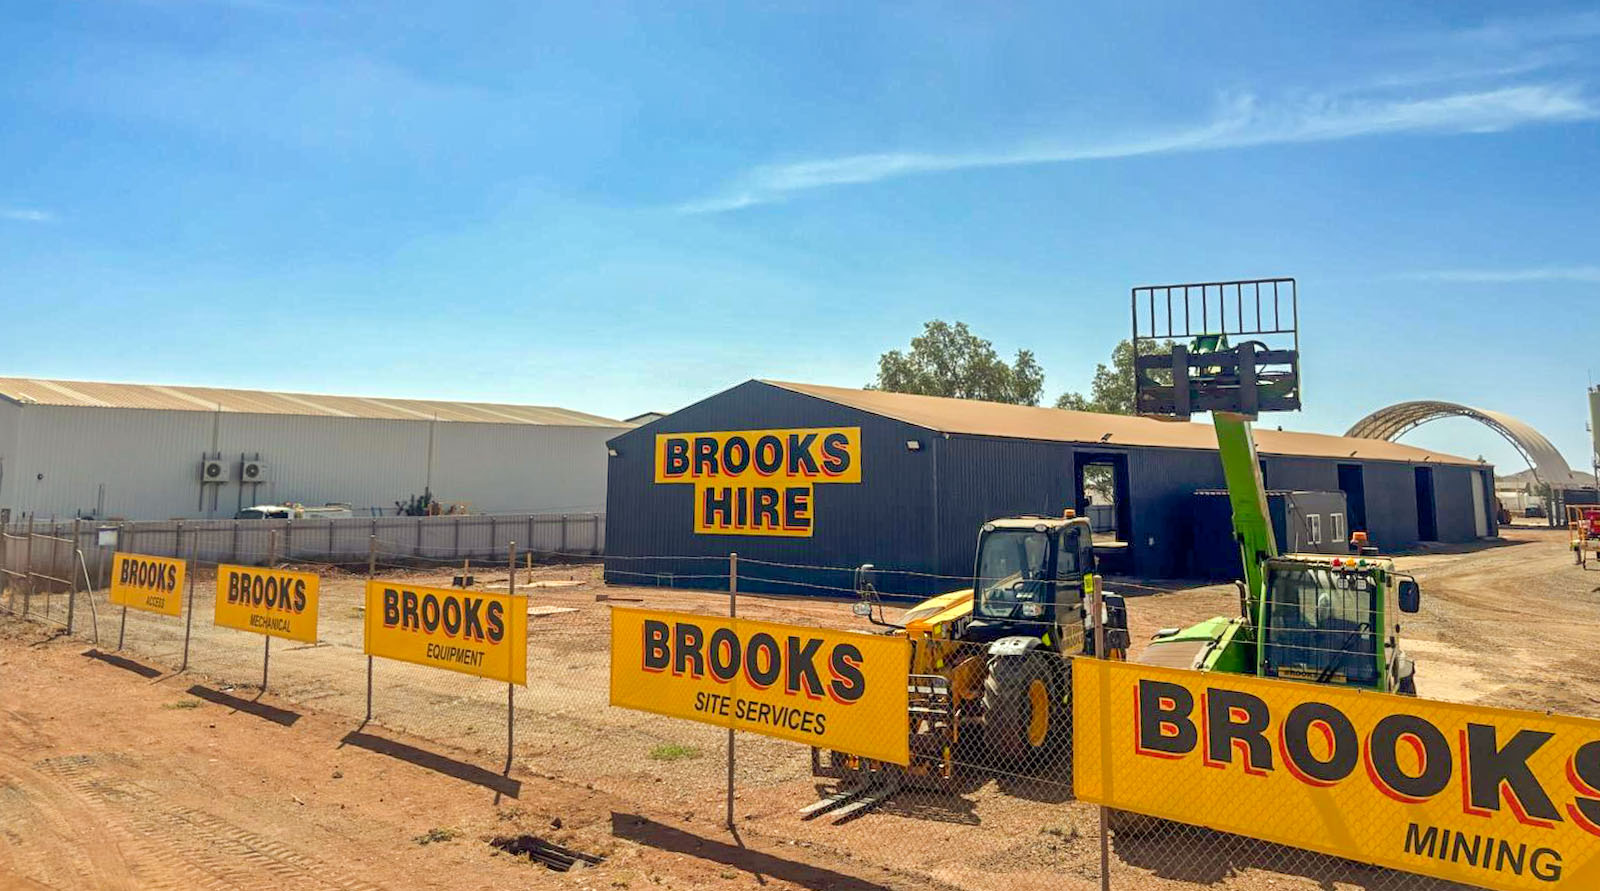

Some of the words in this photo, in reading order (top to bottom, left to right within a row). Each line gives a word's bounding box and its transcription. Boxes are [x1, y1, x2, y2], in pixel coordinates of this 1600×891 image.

[664, 433, 850, 477] BROOKS
[703, 487, 811, 530] HIRE
[120, 558, 176, 594] BROOKS
[228, 571, 306, 614] BROOKS
[249, 613, 291, 632] MECHANICAL
[384, 588, 505, 645] BROOKS
[426, 643, 485, 667] EQUIPMENT
[642, 619, 866, 705] BROOKS
[694, 691, 731, 717] SITE
[735, 698, 826, 735] SERVICES
[1404, 823, 1563, 882] MINING
